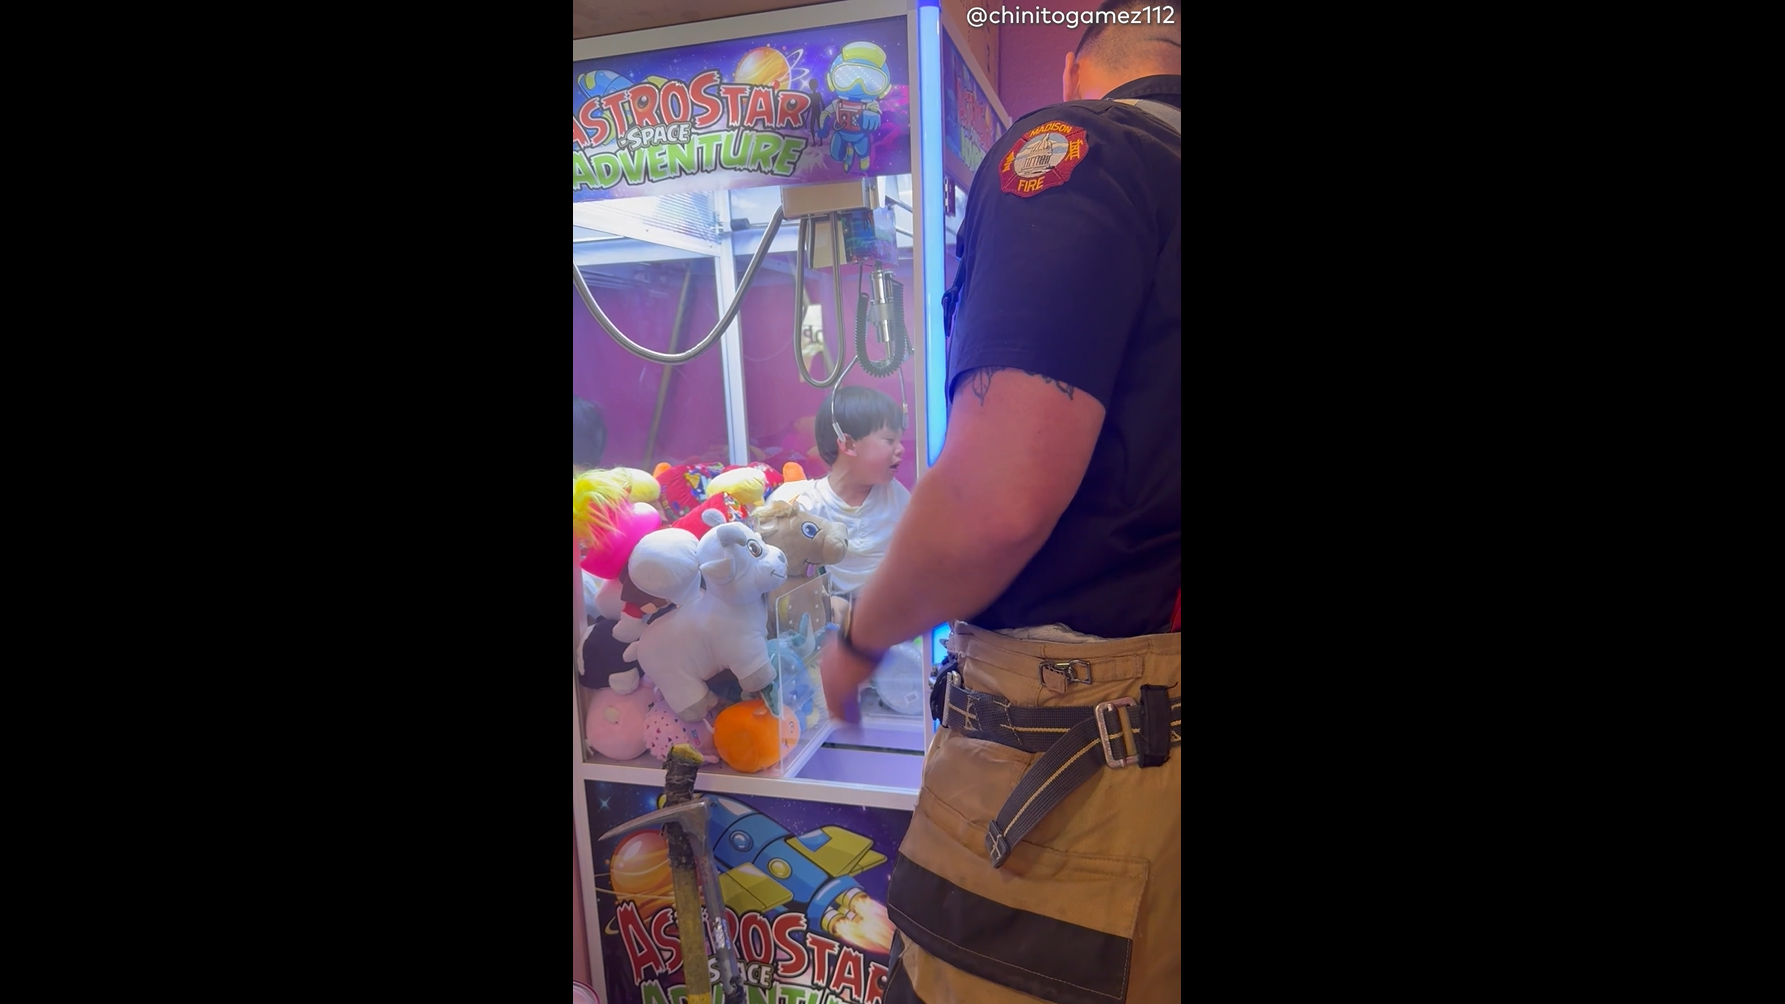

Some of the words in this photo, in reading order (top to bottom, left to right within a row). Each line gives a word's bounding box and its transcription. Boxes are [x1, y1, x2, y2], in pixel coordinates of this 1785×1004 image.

[1029, 122, 1072, 138] MADISON
[573, 132, 806, 189] ADVENTURE
[1017, 176, 1046, 192] FIRE
[707, 957, 773, 989] SCE
